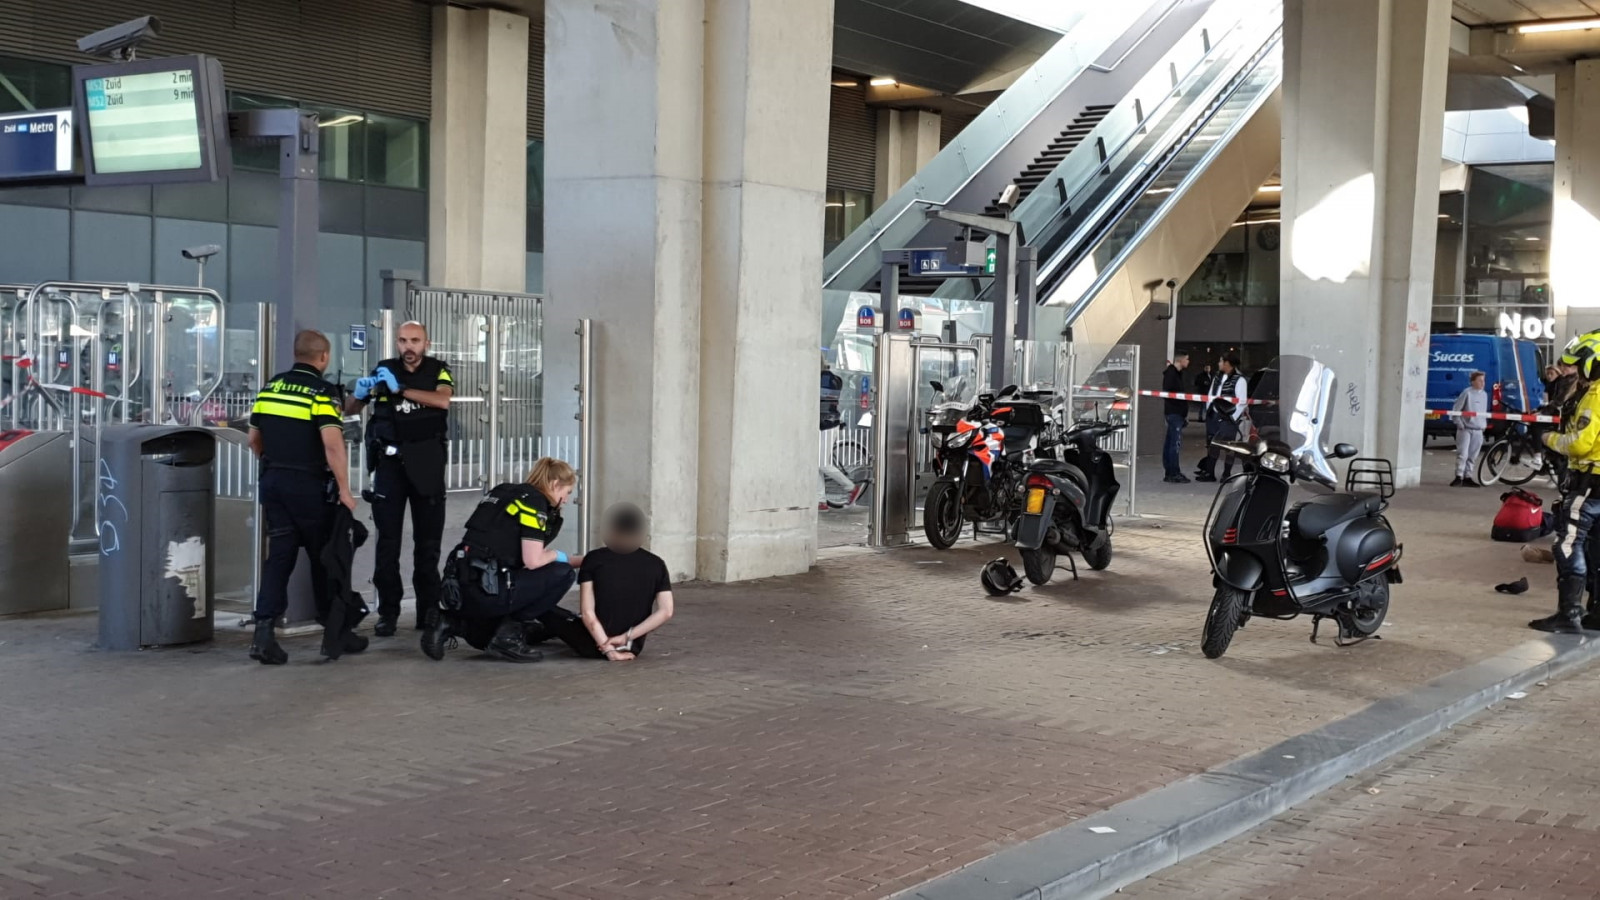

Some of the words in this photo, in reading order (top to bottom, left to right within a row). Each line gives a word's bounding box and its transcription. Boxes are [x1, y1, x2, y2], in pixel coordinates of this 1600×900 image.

[105, 77, 122, 90] Zuid
[172, 72, 178, 84] 2
[107, 93, 124, 106] Zuid
[174, 88, 179, 100] 9
[30, 122, 54, 133] Metro
[60, 352, 67, 363] M
[108, 353, 116, 364] M
[1432, 350, 1475, 362] Succes
[269, 379, 311, 394] POLITIE
